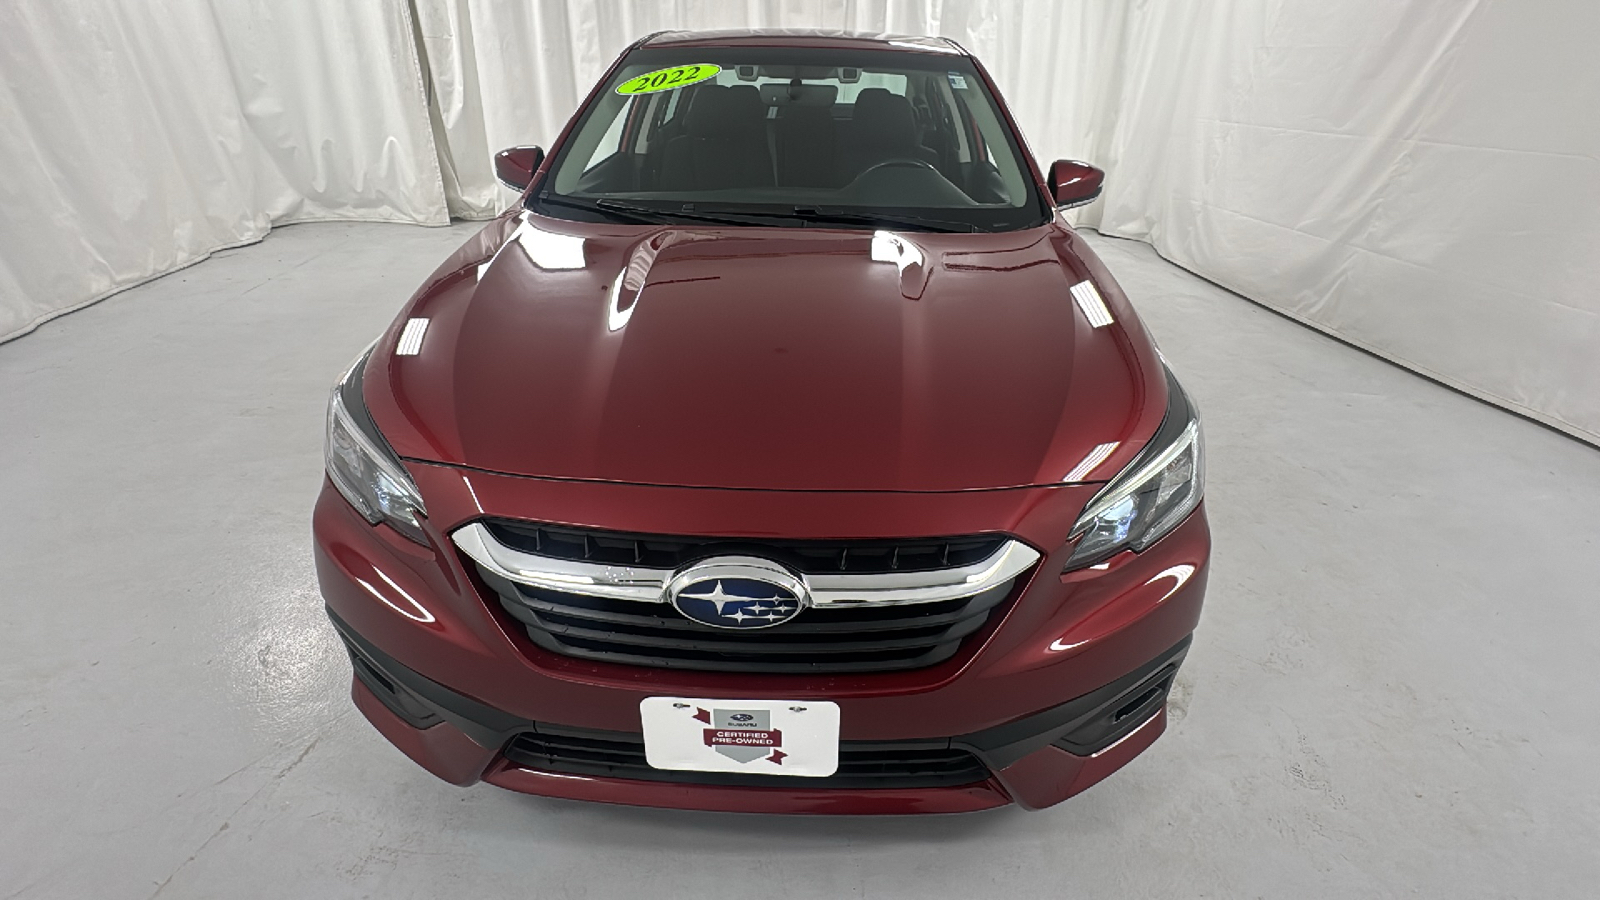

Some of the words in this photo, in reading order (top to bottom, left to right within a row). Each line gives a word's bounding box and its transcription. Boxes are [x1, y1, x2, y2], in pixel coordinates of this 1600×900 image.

[633, 66, 701, 92] 2022
[716, 731, 768, 739] CERTIFIED
[712, 737, 773, 745] PRE-OWNED
